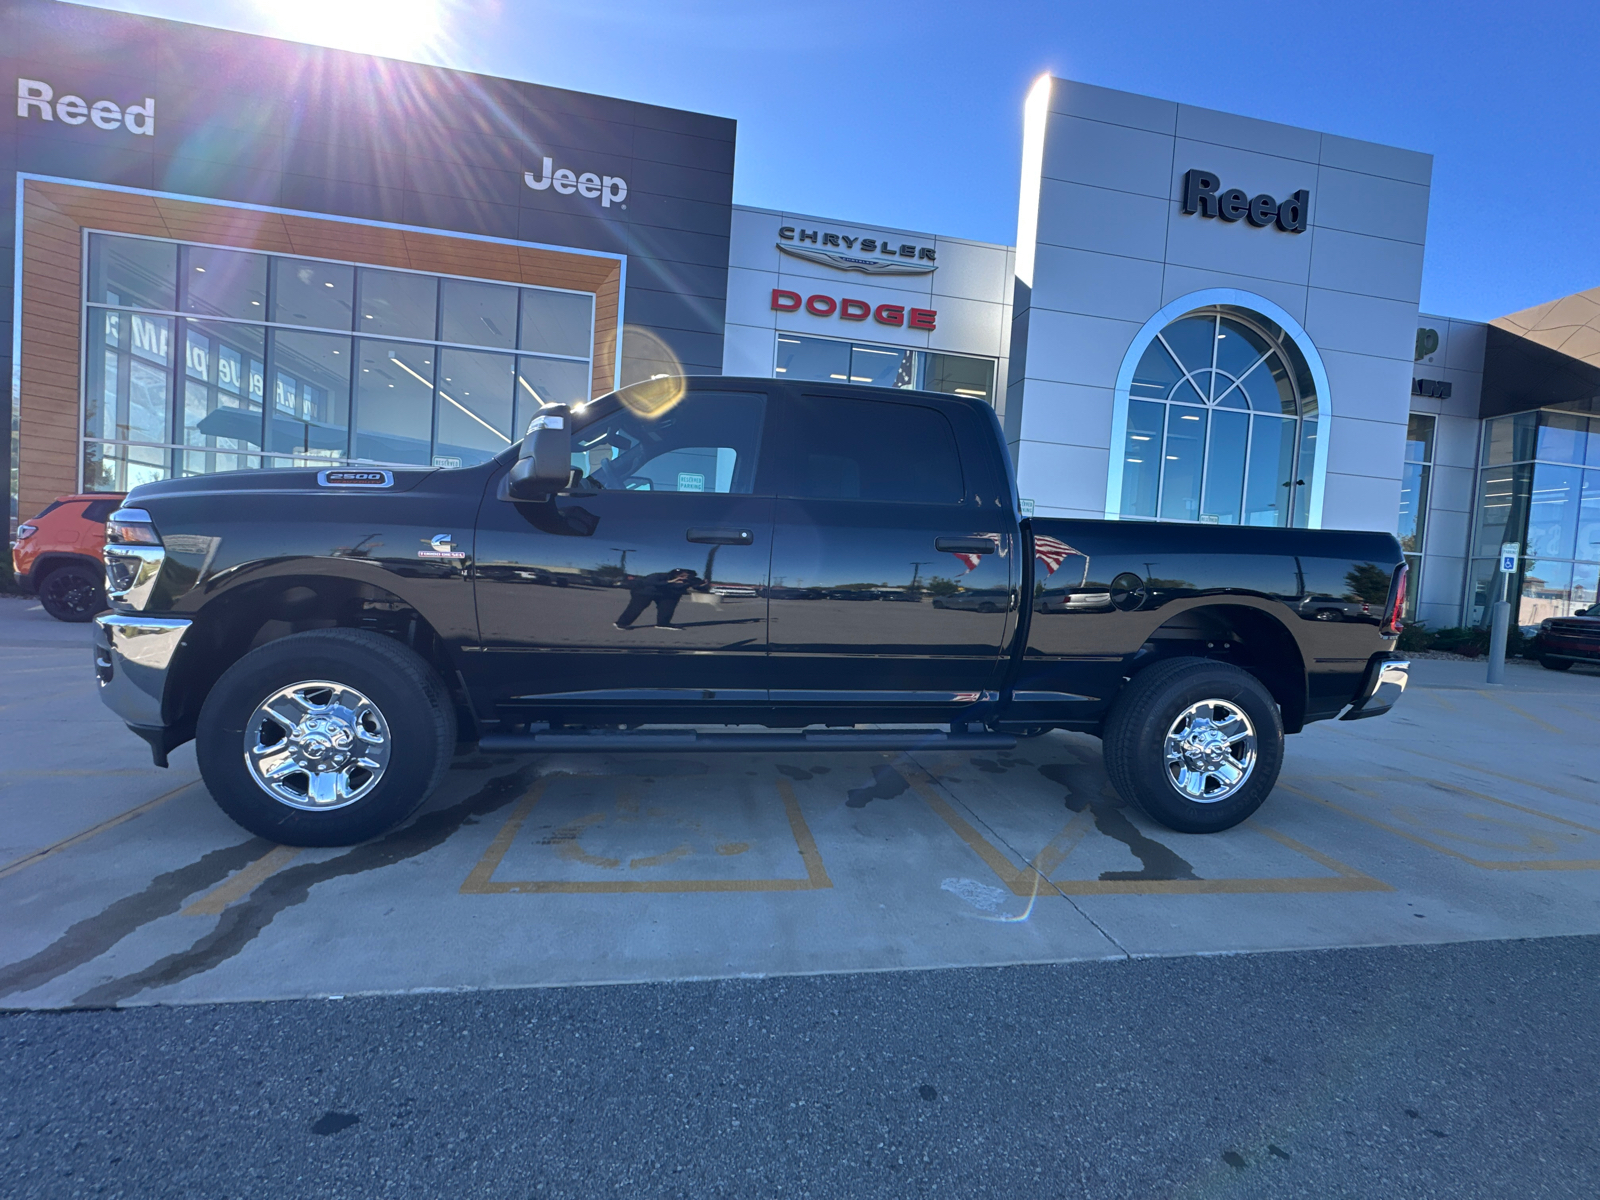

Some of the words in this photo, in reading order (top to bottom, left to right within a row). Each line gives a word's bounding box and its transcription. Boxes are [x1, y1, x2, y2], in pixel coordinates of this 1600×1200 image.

[17, 77, 155, 136] Reed
[1183, 168, 1310, 234] Reed
[778, 225, 937, 261] CHRYSLER
[771, 288, 938, 331] DODGE
[435, 459, 459, 467] RESERVED
[680, 476, 702, 484] RESERVED
